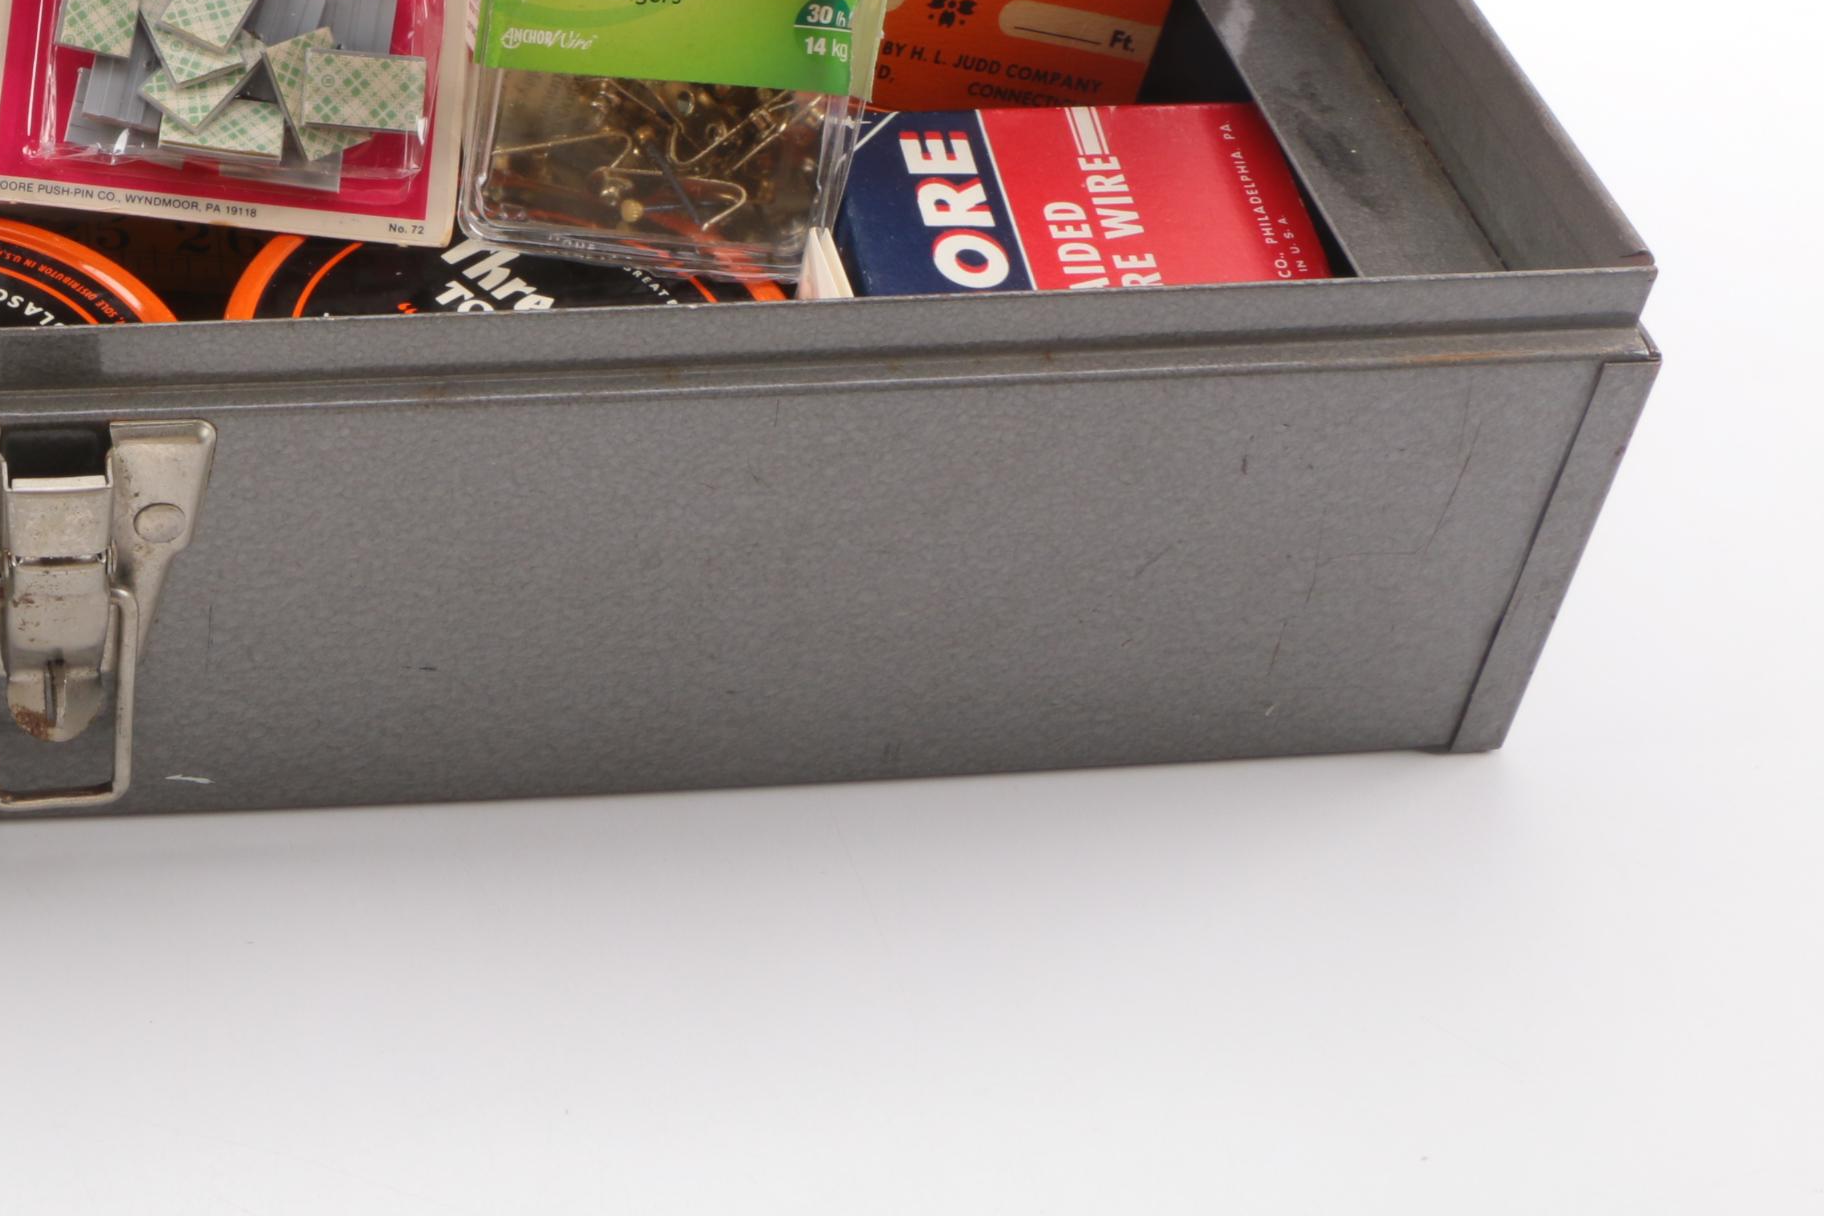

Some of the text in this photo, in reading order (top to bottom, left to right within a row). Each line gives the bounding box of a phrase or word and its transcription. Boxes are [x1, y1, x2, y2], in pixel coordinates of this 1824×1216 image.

[806, 4, 833, 24] 30
[805, 36, 848, 62] 14 kg
[1110, 30, 1135, 52] Ft.
[883, 41, 1103, 94] BY H. L. JUDD COMPANY
[37, 184, 94, 199] PUSH-PIN
[97, 189, 121, 203] CO.,
[125, 193, 201, 212] WYNDMOOR,
[206, 201, 222, 214] PA
[226, 204, 257, 218] 19118
[1078, 154, 1144, 239] WIRE
[389, 223, 425, 235] No. 72
[38, 263, 98, 301] DISTRIBUTOR
